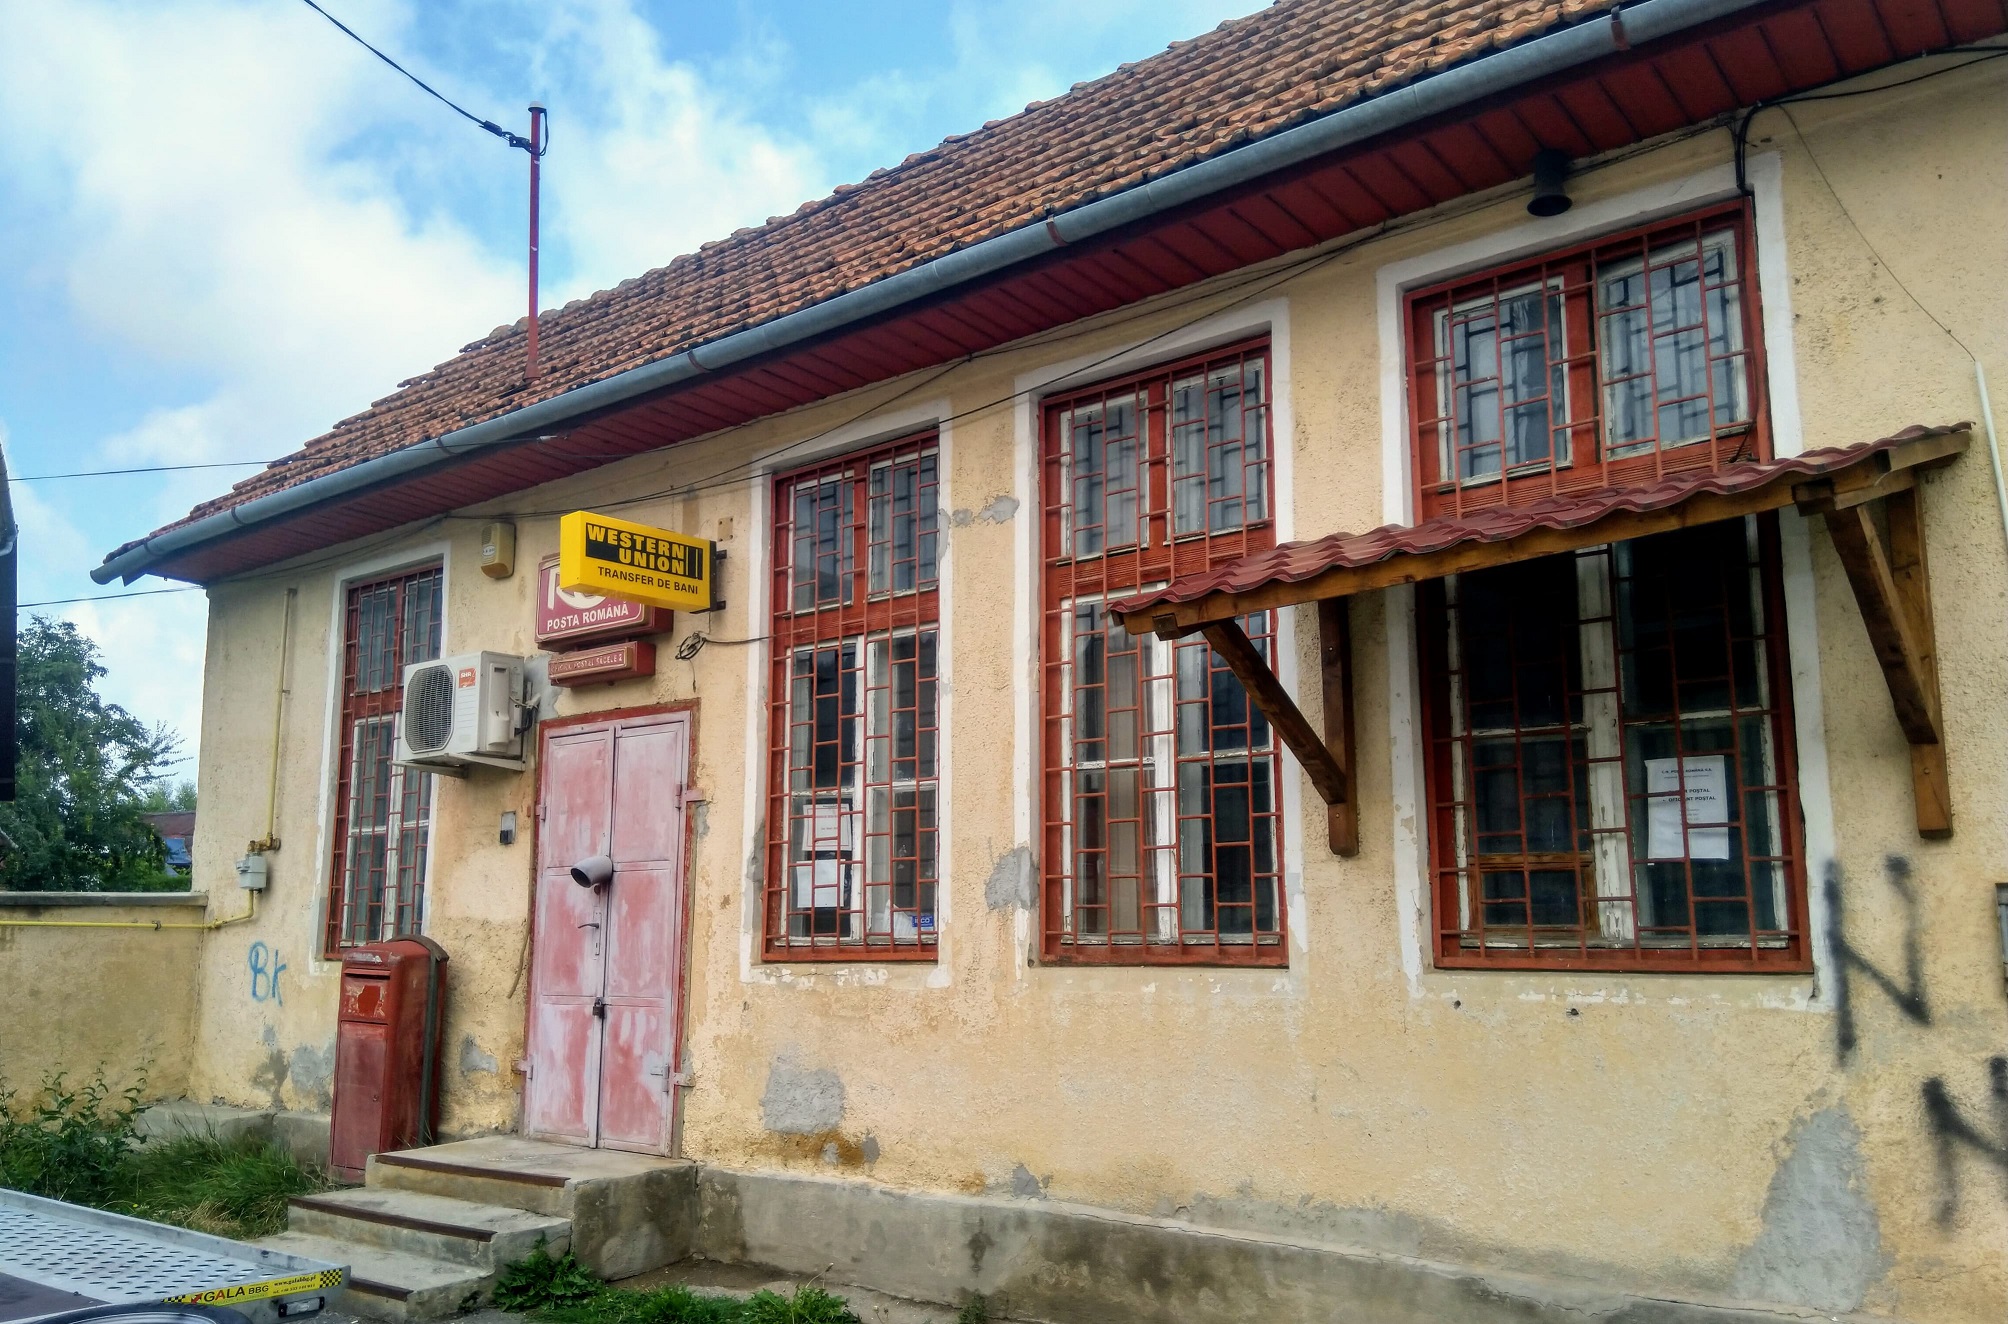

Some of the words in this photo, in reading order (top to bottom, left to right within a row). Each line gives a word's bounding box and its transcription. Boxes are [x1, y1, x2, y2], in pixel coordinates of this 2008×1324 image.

[587, 524, 684, 560] WESTERN
[618, 547, 684, 575] UNION
[597, 566, 654, 586] TRANSFER
[657, 578, 671, 590] DE
[674, 582, 698, 595] BANI
[582, 601, 629, 624] ROMÂNĂ
[203, 1286, 245, 1302] GALA
[248, 1285, 269, 1295] BBG
